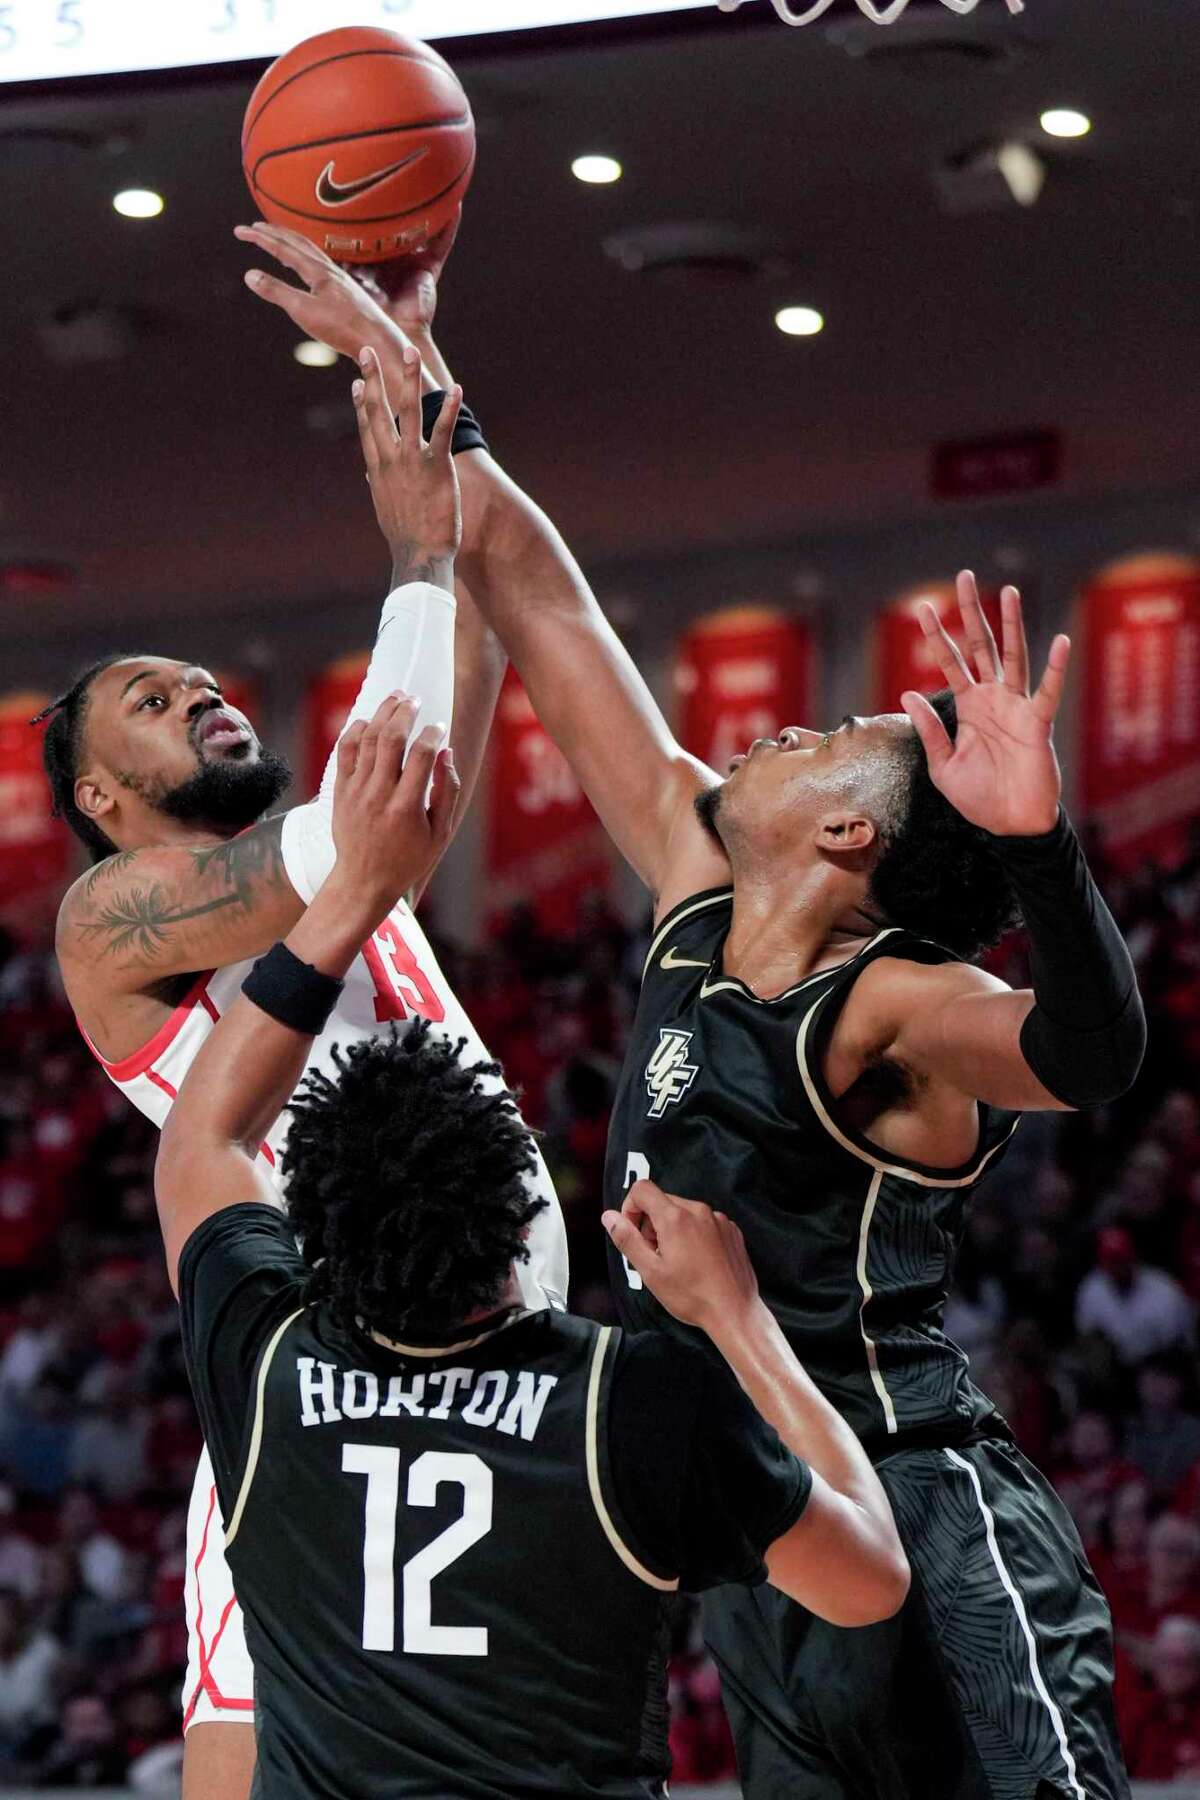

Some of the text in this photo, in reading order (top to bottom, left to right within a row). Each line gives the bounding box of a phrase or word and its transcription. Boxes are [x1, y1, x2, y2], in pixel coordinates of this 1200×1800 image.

[361, 917, 446, 1023] 13
[646, 1028, 699, 1119] UCF
[296, 1356, 558, 1442] HORTON
[341, 1442, 493, 1657] 12
